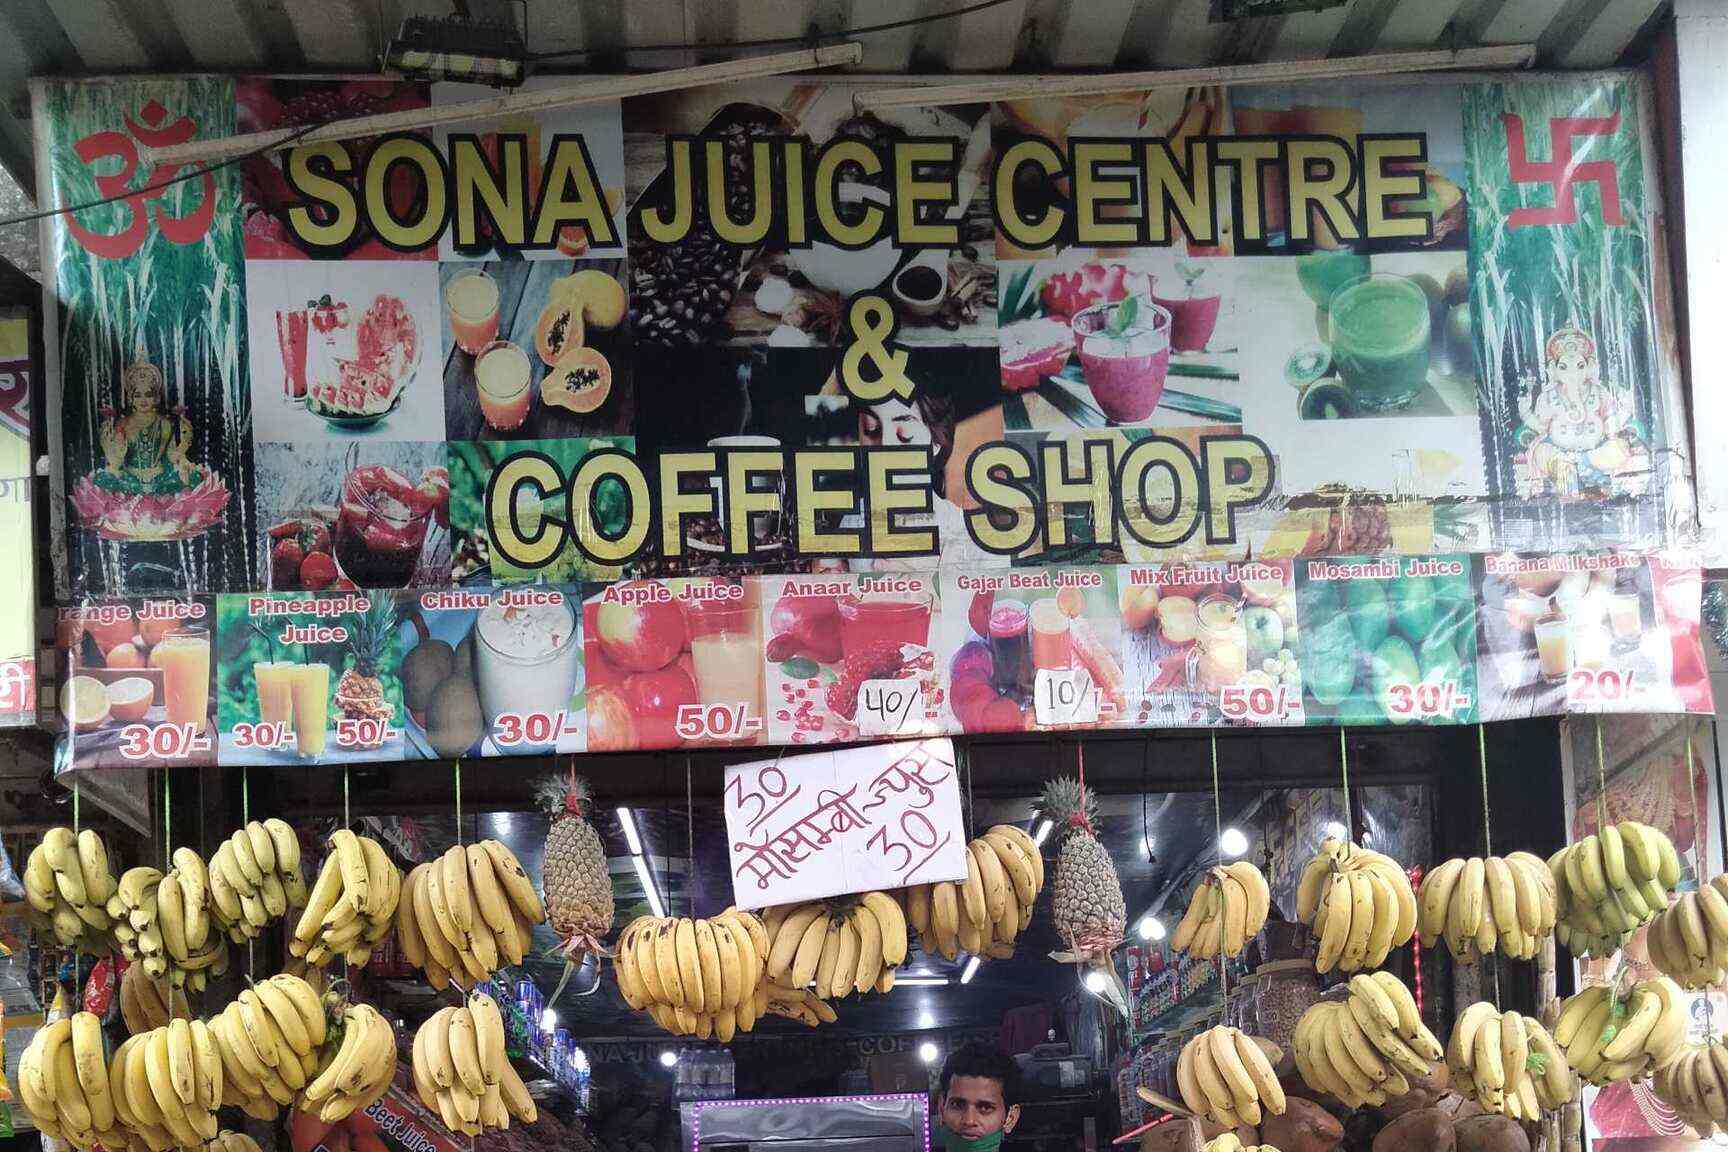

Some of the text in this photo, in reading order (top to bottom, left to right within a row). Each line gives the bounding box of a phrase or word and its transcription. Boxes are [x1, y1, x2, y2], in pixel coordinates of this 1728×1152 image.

[283, 132, 1431, 254] SONA JUICE CENTRE
[840, 291, 916, 404] &
[485, 435, 1277, 574] COFFEE SHOP
[956, 570, 1102, 593] Gajar Beat Juice
[1129, 563, 1284, 585] Mix Fruit Juice
[1308, 558, 1463, 580] Mosambi Juice
[420, 589, 563, 610] Chiku Juice
[602, 582, 744, 606] Apple Juice
[782, 577, 923, 599] Anaar Juice
[58, 600, 206, 625] range Juice
[248, 594, 370, 617] Pineapple
[280, 624, 348, 644] Juice
[1219, 684, 1301, 719] 50/-
[1388, 684, 1470, 715] 30/-
[336, 719, 397, 747] 50/-
[493, 711, 578, 745] 30/-
[675, 704, 763, 738] 50/-
[119, 722, 212, 760] 30/-
[233, 722, 297, 748] 30/-
[364, 1098, 402, 1137] Beet
